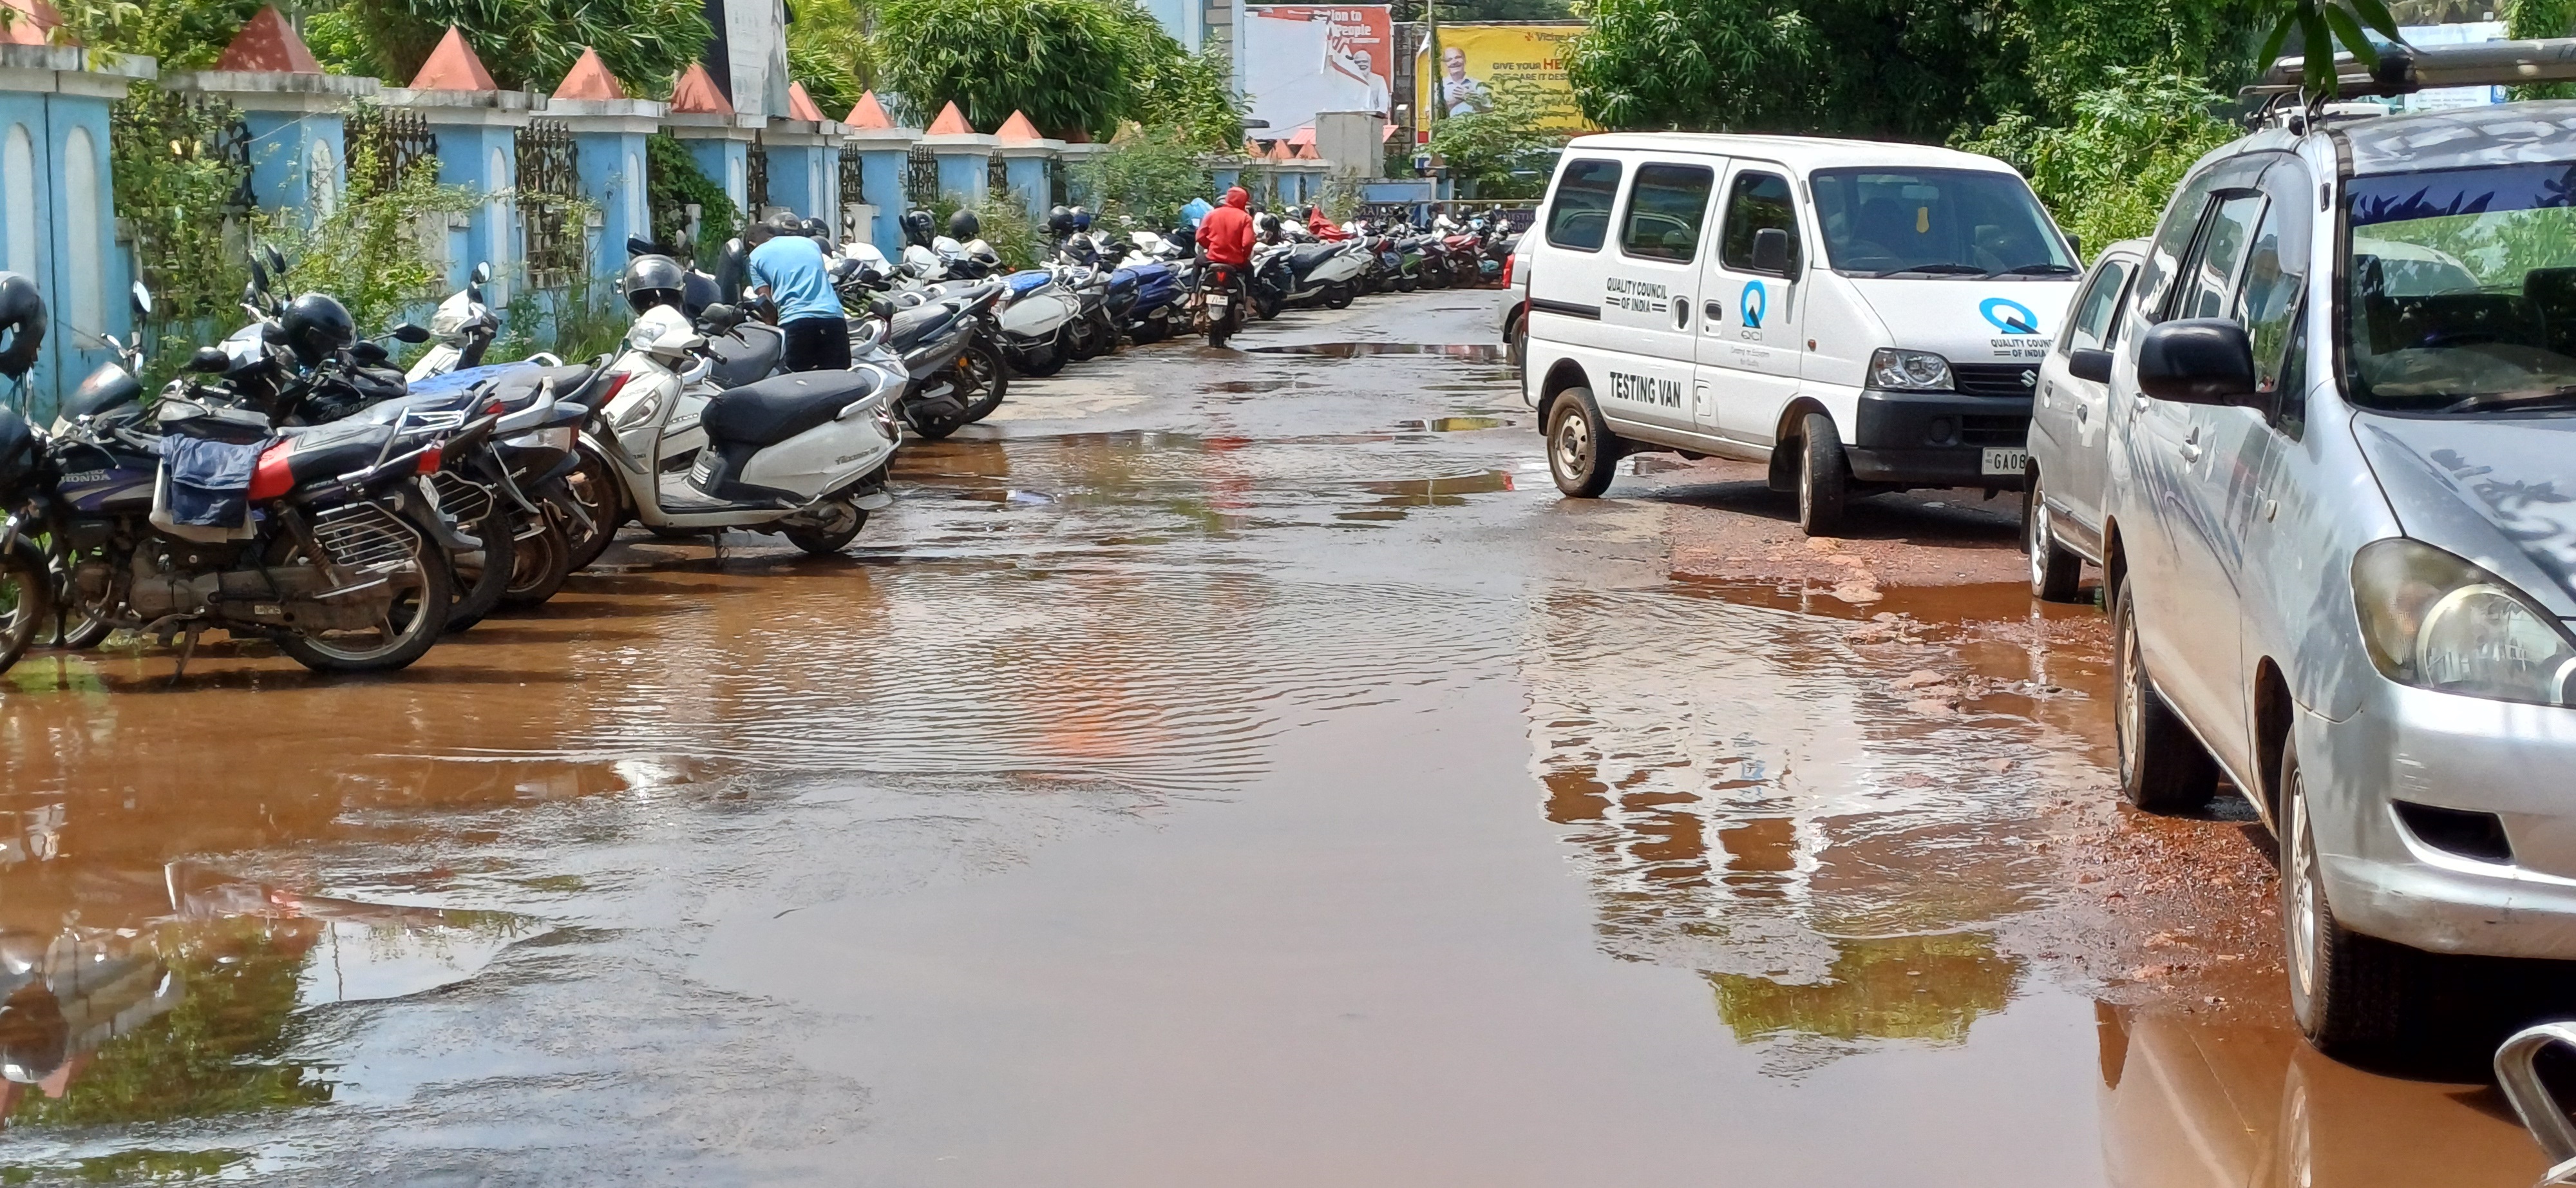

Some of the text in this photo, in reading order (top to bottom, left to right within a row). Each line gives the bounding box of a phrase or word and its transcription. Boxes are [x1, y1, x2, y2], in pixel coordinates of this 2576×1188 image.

[1331, 10, 1362, 21] ion to
[1492, 57, 1563, 70] GIVE YOUR HE
[1606, 277, 1667, 300] QUALITY COUNCIL
[1621, 297, 1651, 313] OF INDIA
[1741, 330, 1763, 342] QCI
[1991, 339, 2025, 348] QUALITY
[2012, 349, 2047, 358] OF INDIA
[1610, 371, 1681, 408] TESTING VAN
[1994, 454, 2027, 470] GA08
[61, 474, 111, 483] HONDA
